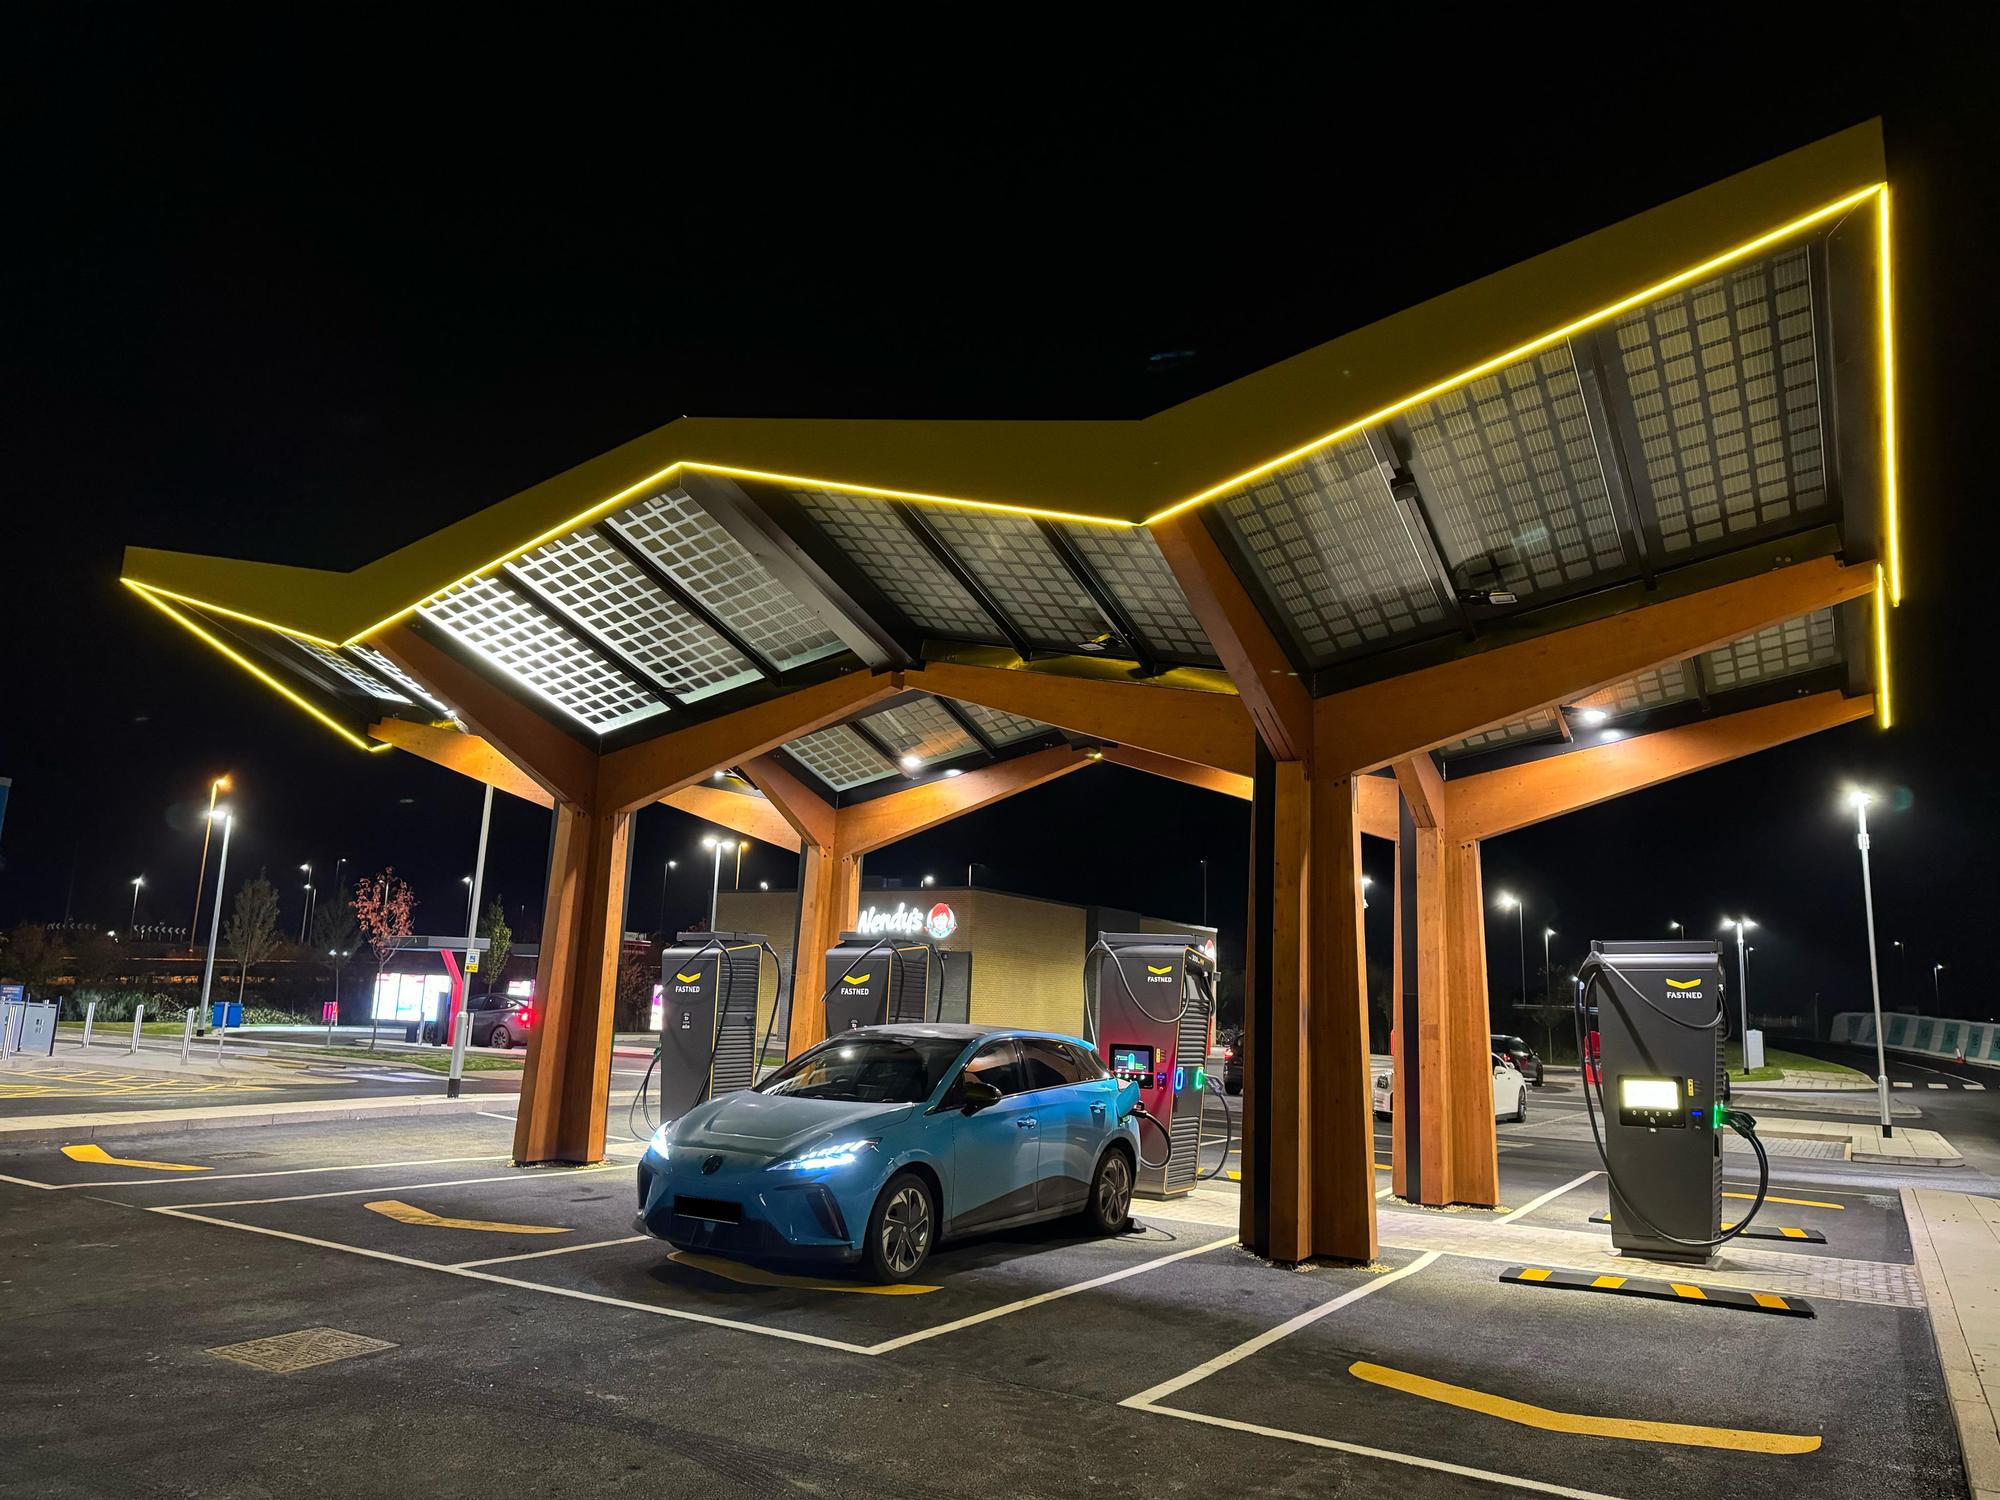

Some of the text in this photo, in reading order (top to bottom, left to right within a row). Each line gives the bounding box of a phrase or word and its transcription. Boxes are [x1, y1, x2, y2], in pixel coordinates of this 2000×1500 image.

[675, 985, 701, 993] FASTNED
[840, 987, 870, 996] FASTNED
[1666, 991, 1703, 999] FASTNED
